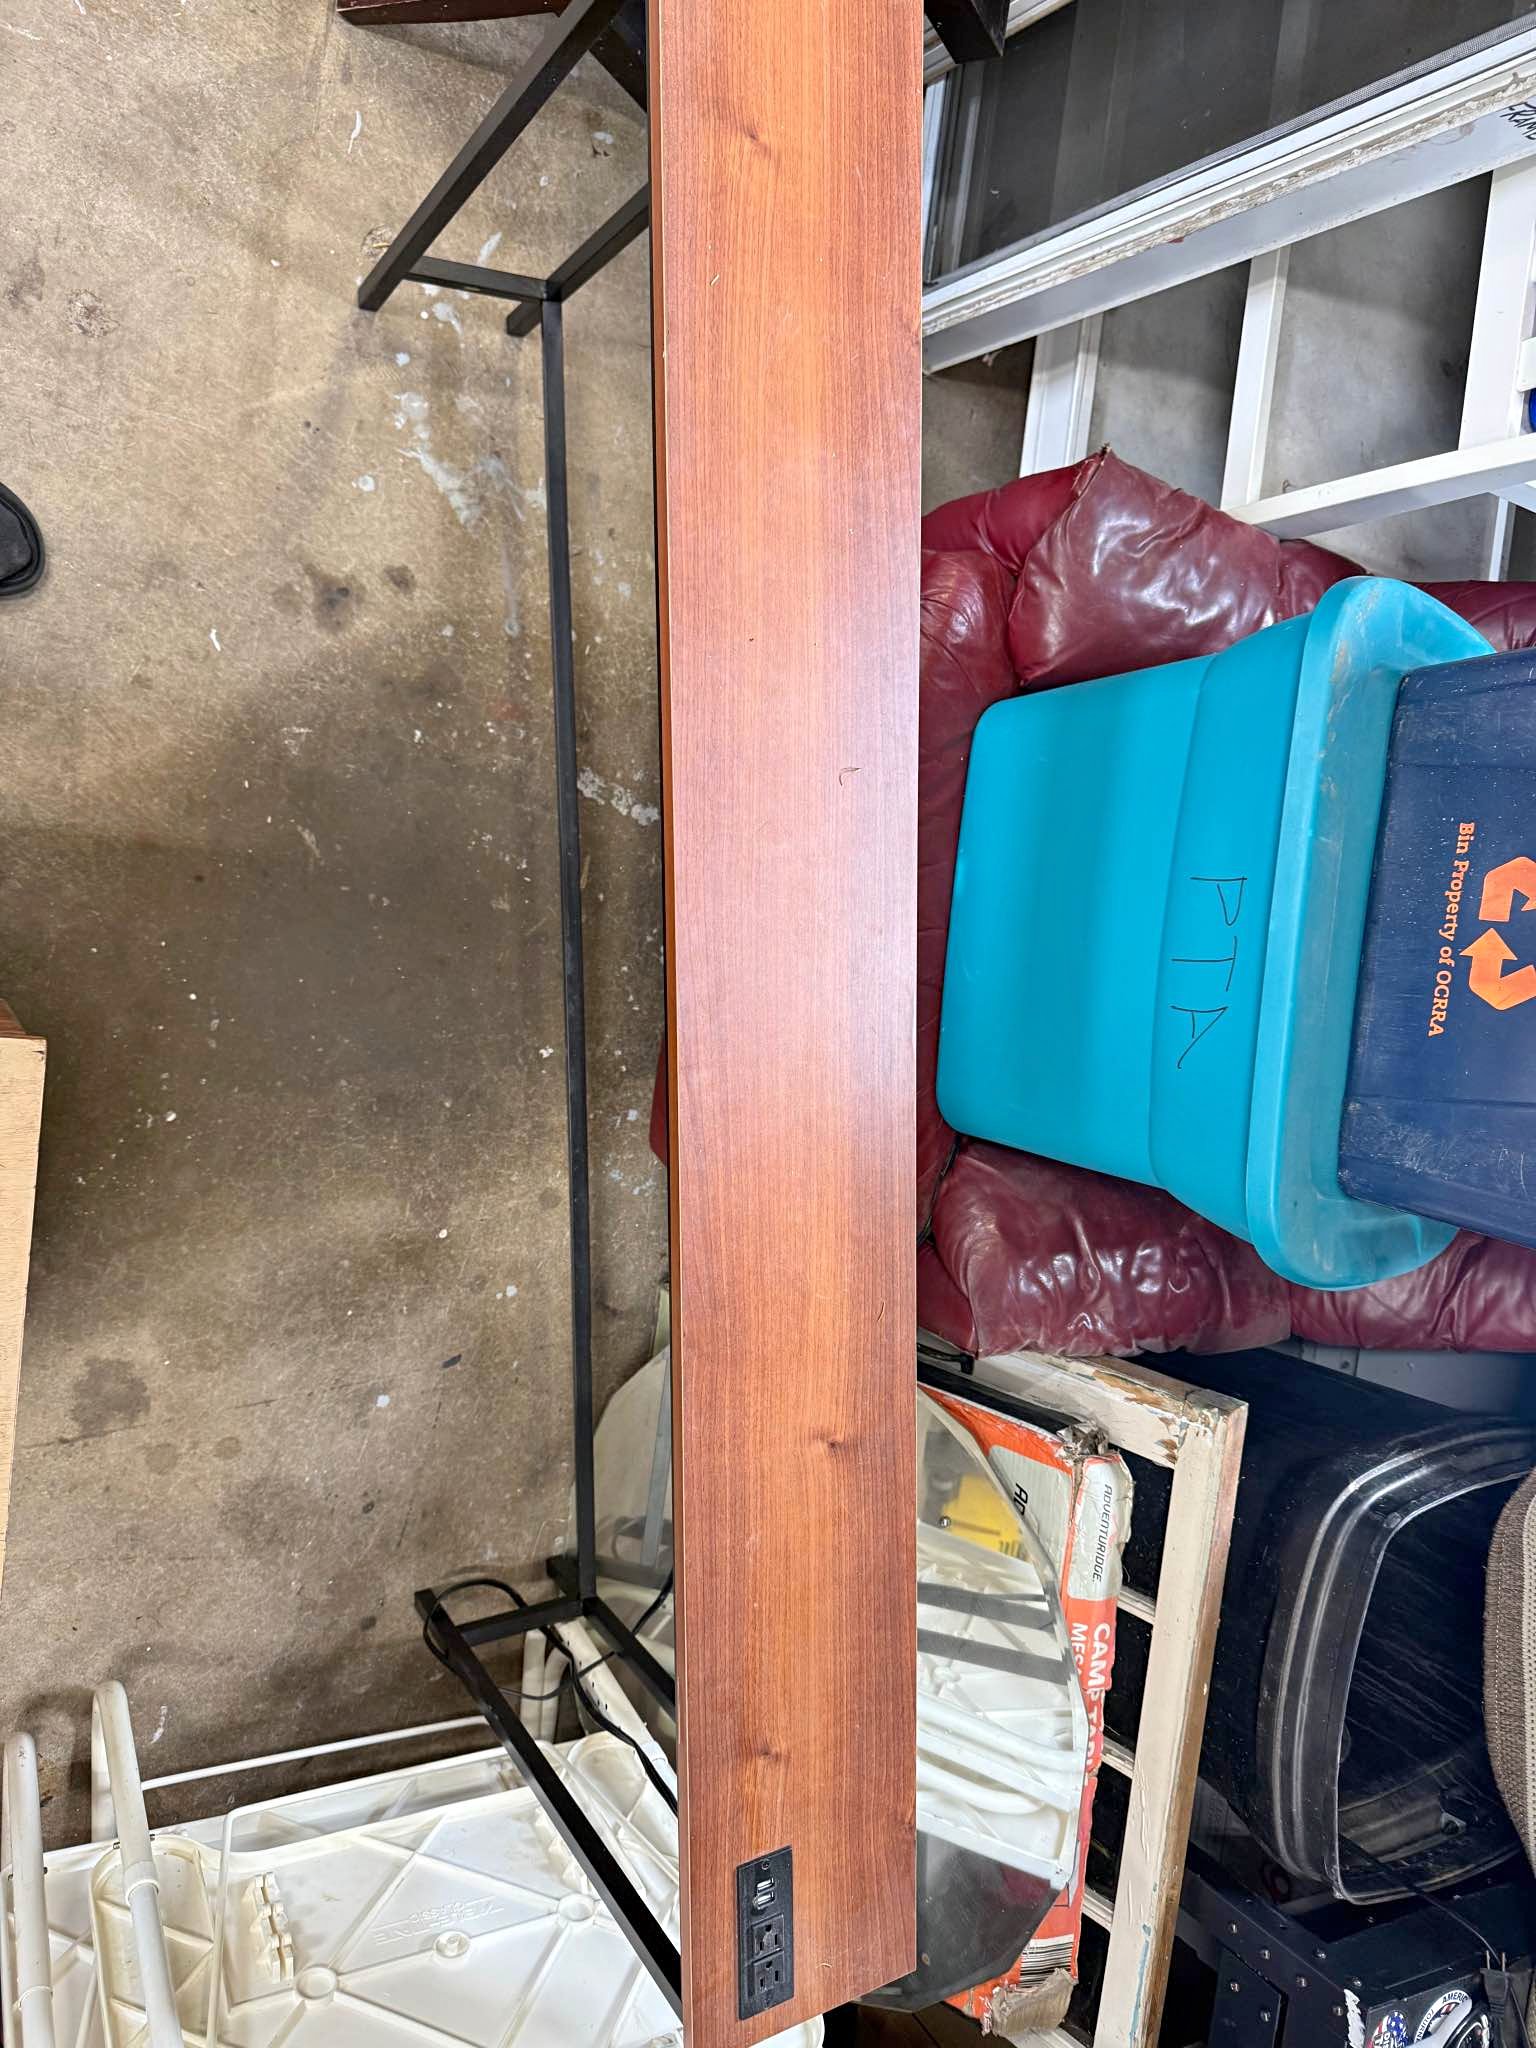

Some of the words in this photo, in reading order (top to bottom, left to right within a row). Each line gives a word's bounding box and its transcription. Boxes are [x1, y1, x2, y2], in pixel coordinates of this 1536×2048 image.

[1455, 821, 1476, 855] Bin
[1438, 860, 1470, 941] Property
[1439, 946, 1456, 968] of
[1427, 969, 1453, 1038] OCRRA
[1086, 1622, 1110, 1702] CAMP
